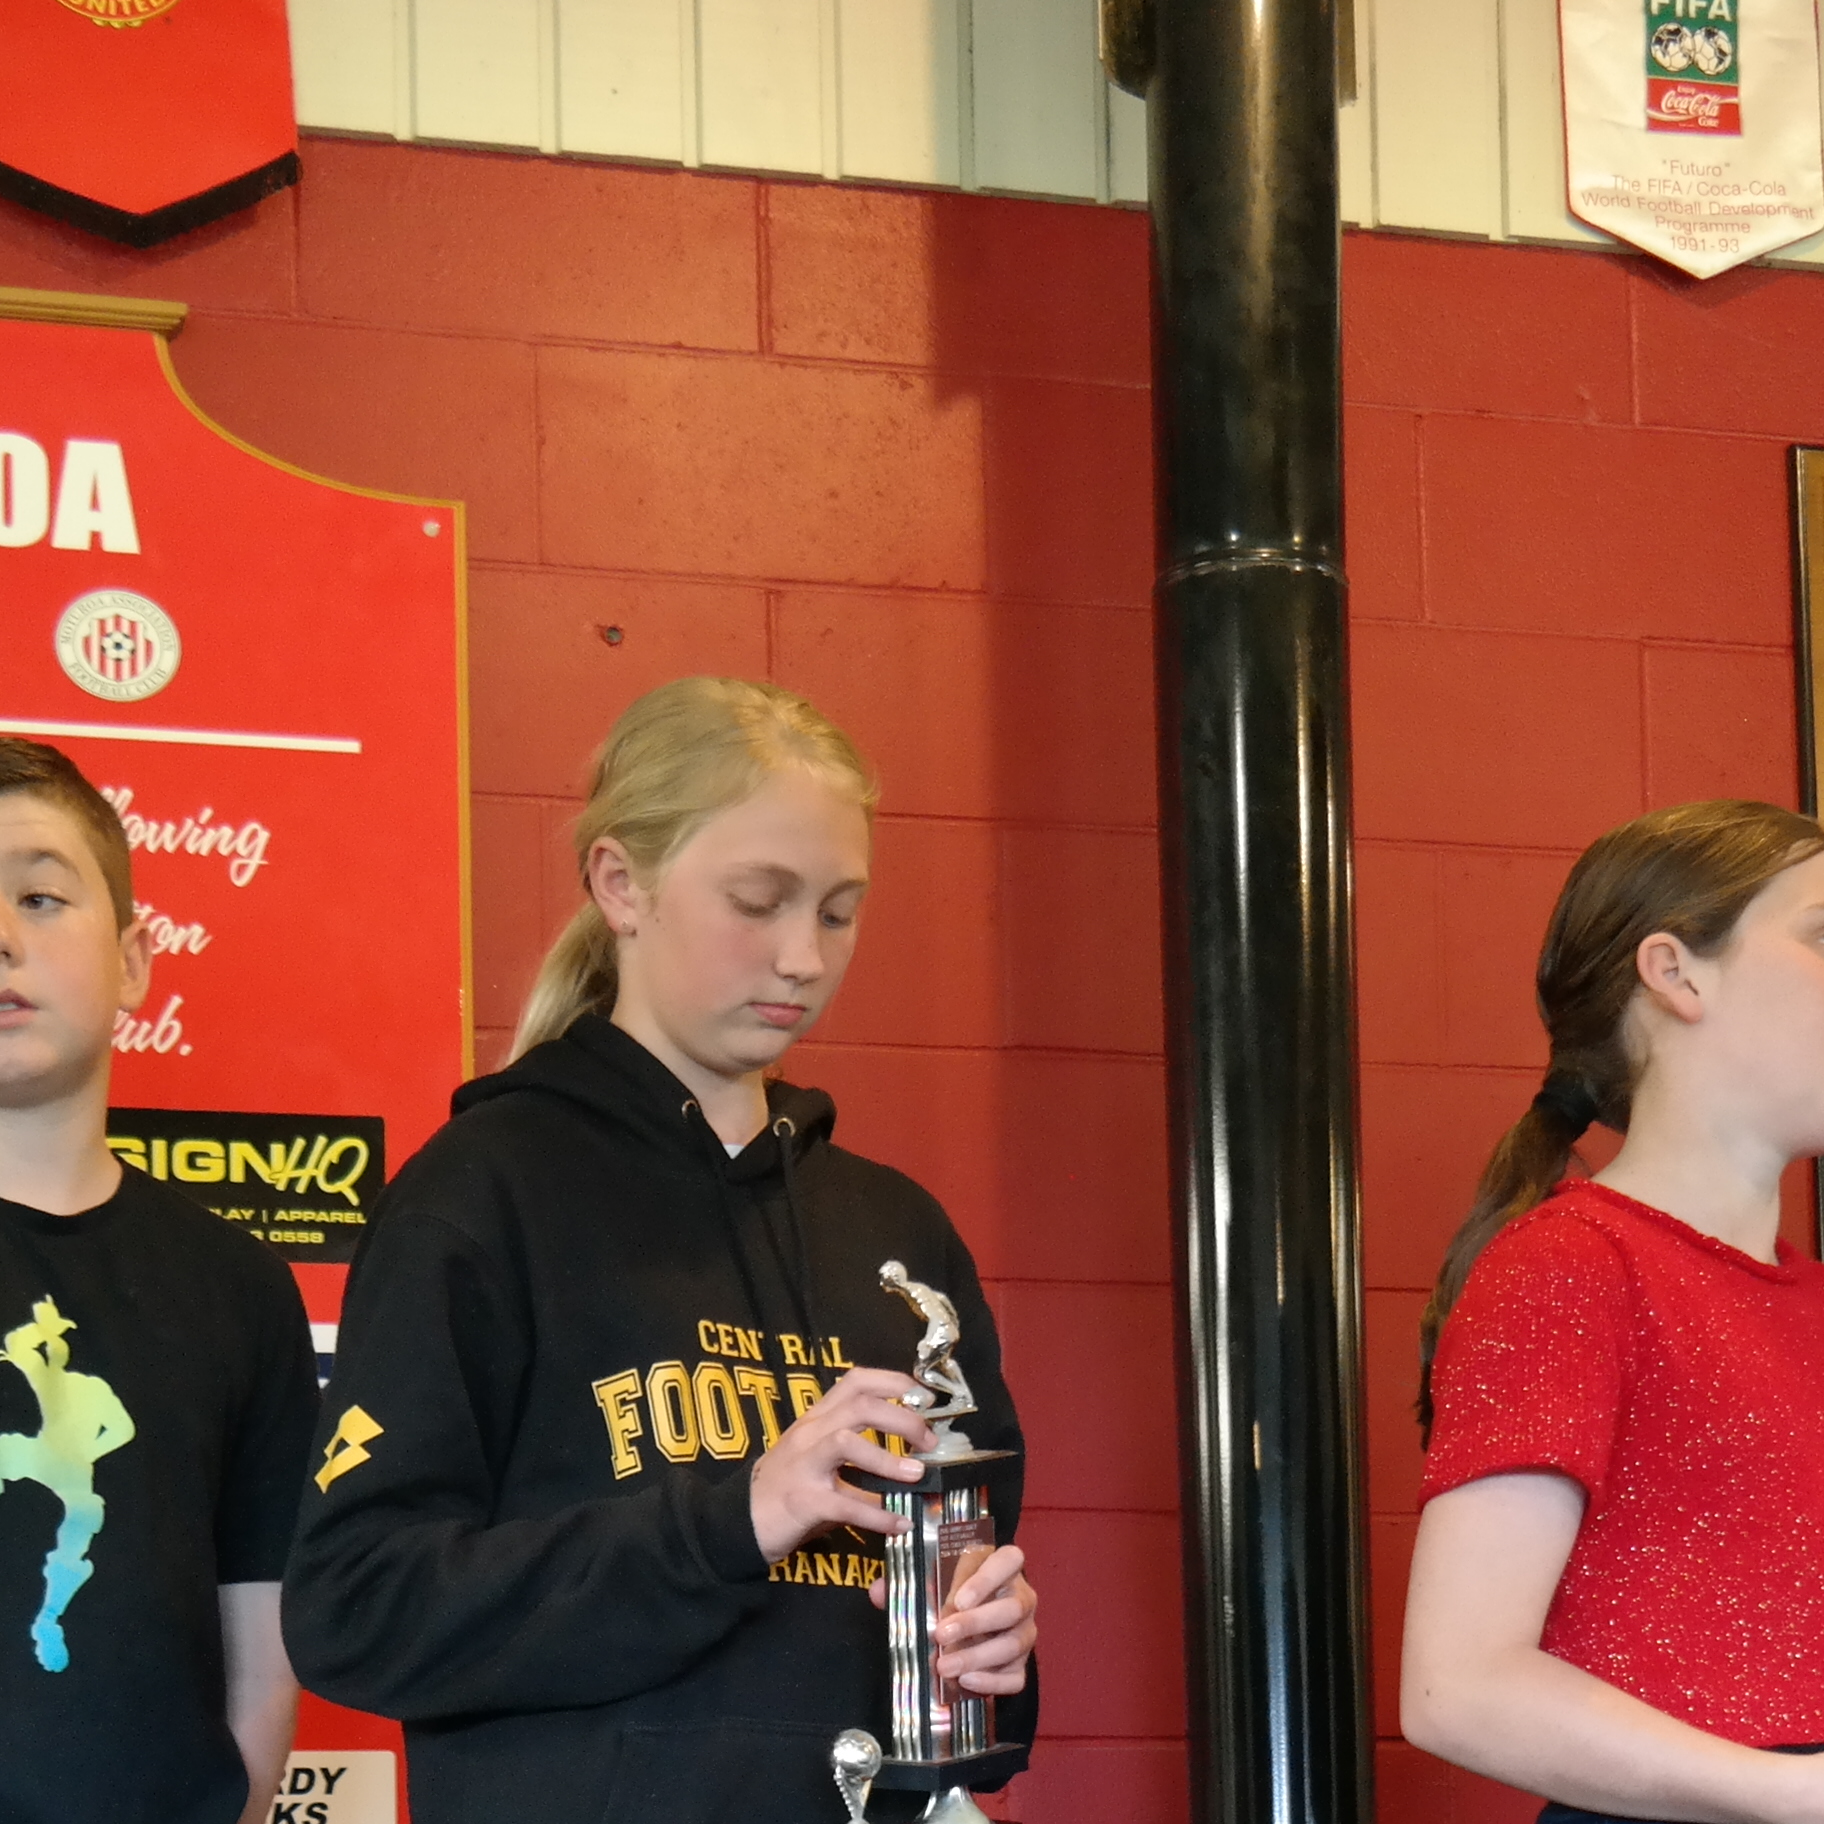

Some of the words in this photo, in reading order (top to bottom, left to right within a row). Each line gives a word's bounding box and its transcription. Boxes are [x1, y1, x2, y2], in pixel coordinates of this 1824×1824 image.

[1661, 89, 1720, 117] Coca-Cola
[1662, 160, 1730, 177] "Futuro"
[1612, 175, 1641, 192] The
[1647, 179, 1683, 195] FIFA
[1696, 181, 1786, 197] Coca-Cola
[1581, 192, 1630, 208] World
[1637, 197, 1701, 215] Football
[1708, 201, 1815, 220] Development
[1655, 215, 1751, 235] Programme
[274, 1210, 367, 1224] APPAREL
[278, 1767, 348, 1796] DY
